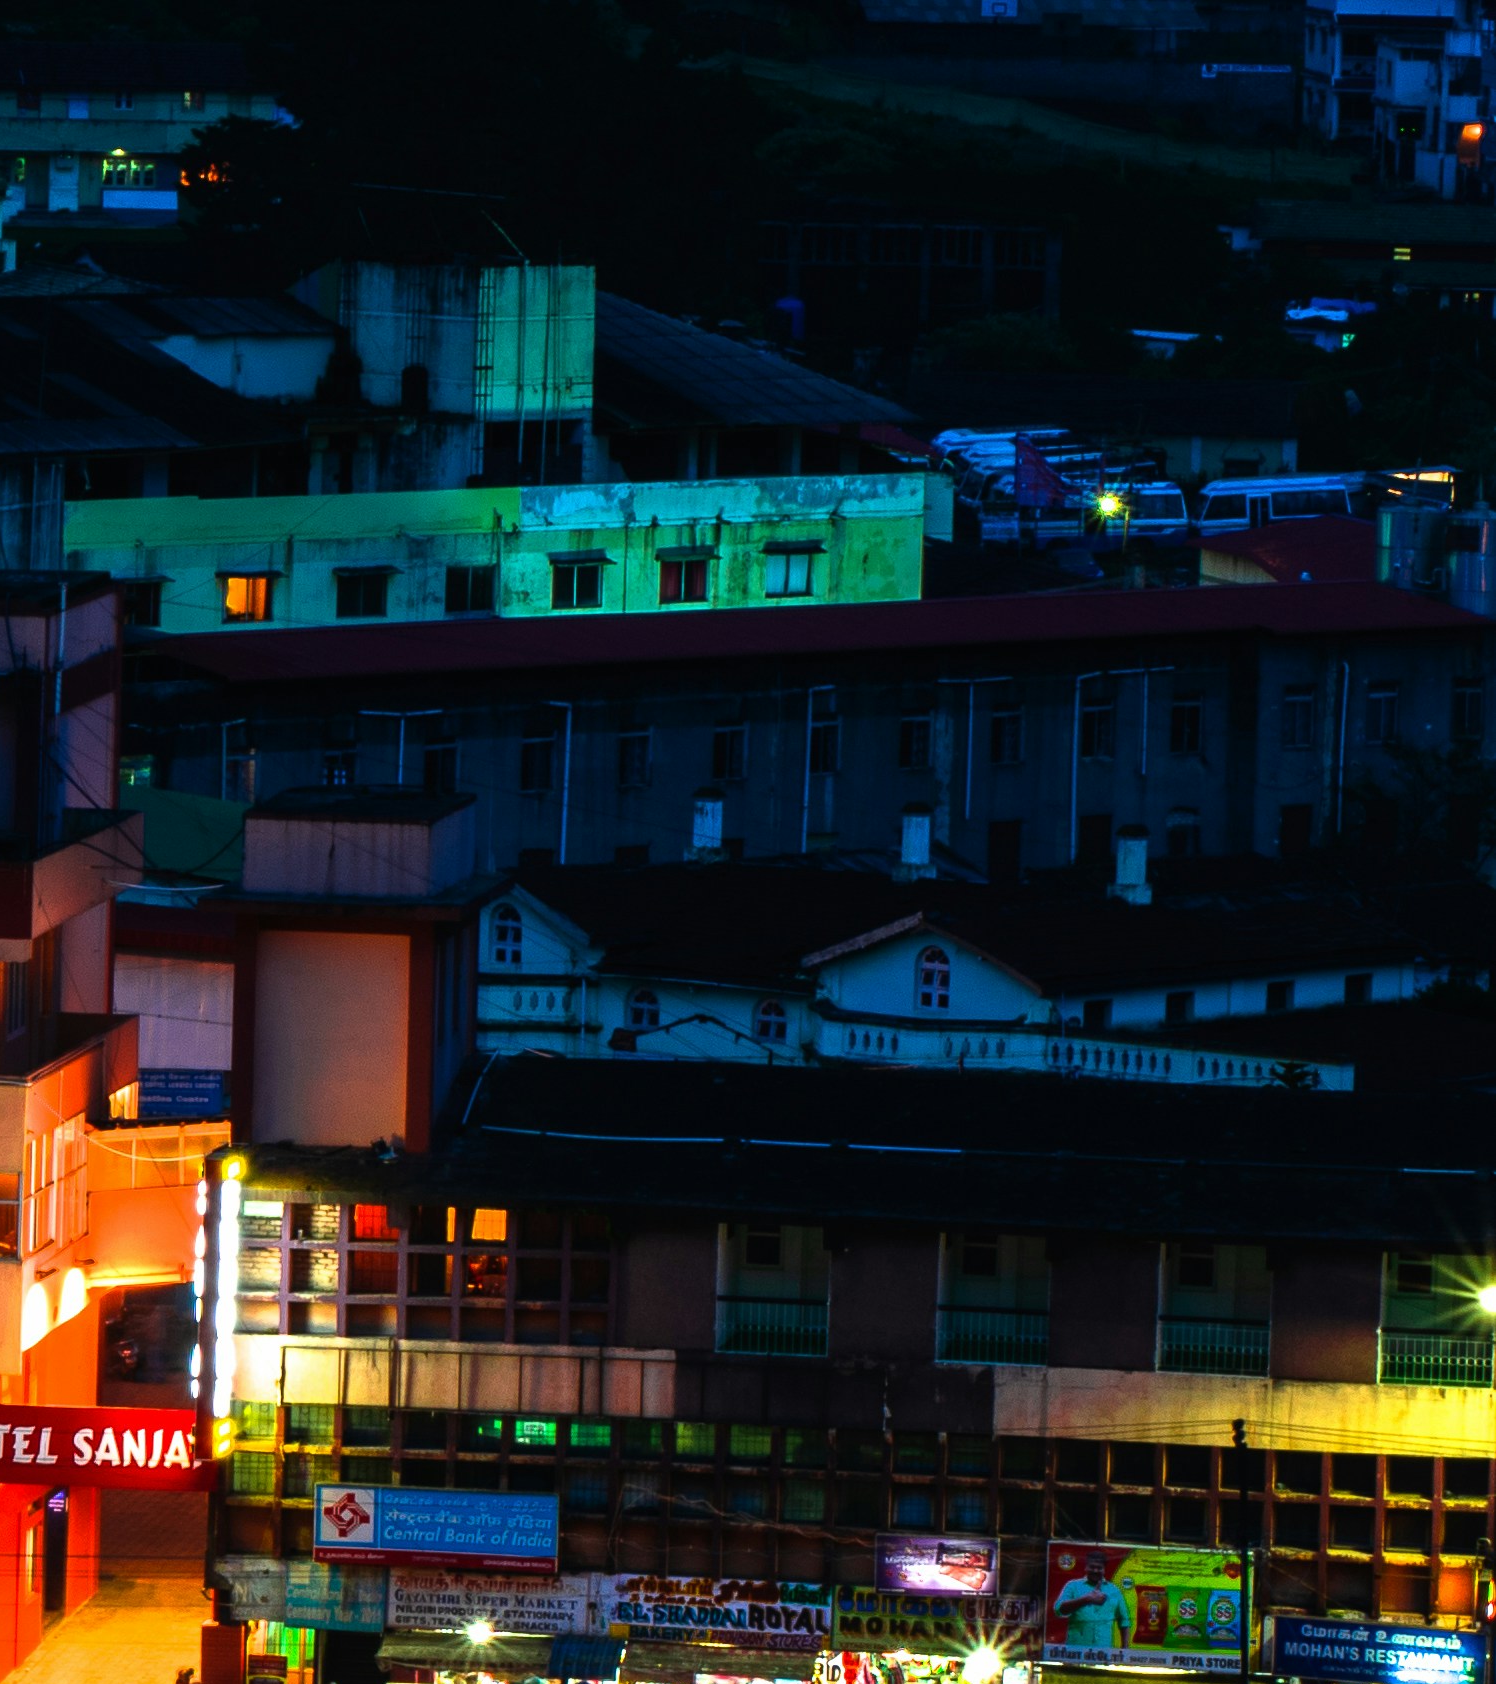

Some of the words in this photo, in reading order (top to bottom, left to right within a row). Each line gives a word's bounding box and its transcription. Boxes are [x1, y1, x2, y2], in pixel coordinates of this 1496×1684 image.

[383, 1526, 441, 1544] Central
[445, 1527, 484, 1545] Bank
[491, 1528, 508, 1546] of
[511, 1529, 553, 1547] India
[396, 1605, 436, 1614] NILGIRI
[513, 1594, 578, 1610] MARKET
[748, 1603, 831, 1636] ROYAL
[838, 1615, 960, 1637] MOHAN
[630, 1625, 694, 1642] BAKERY
[766, 1632, 821, 1649] STORES
[1300, 1623, 1370, 1642] மோகன்
[1171, 1654, 1203, 1667] PRIYA
[1284, 1641, 1360, 1661] MOHAN'S
[1364, 1649, 1475, 1672] RESTAURANT
